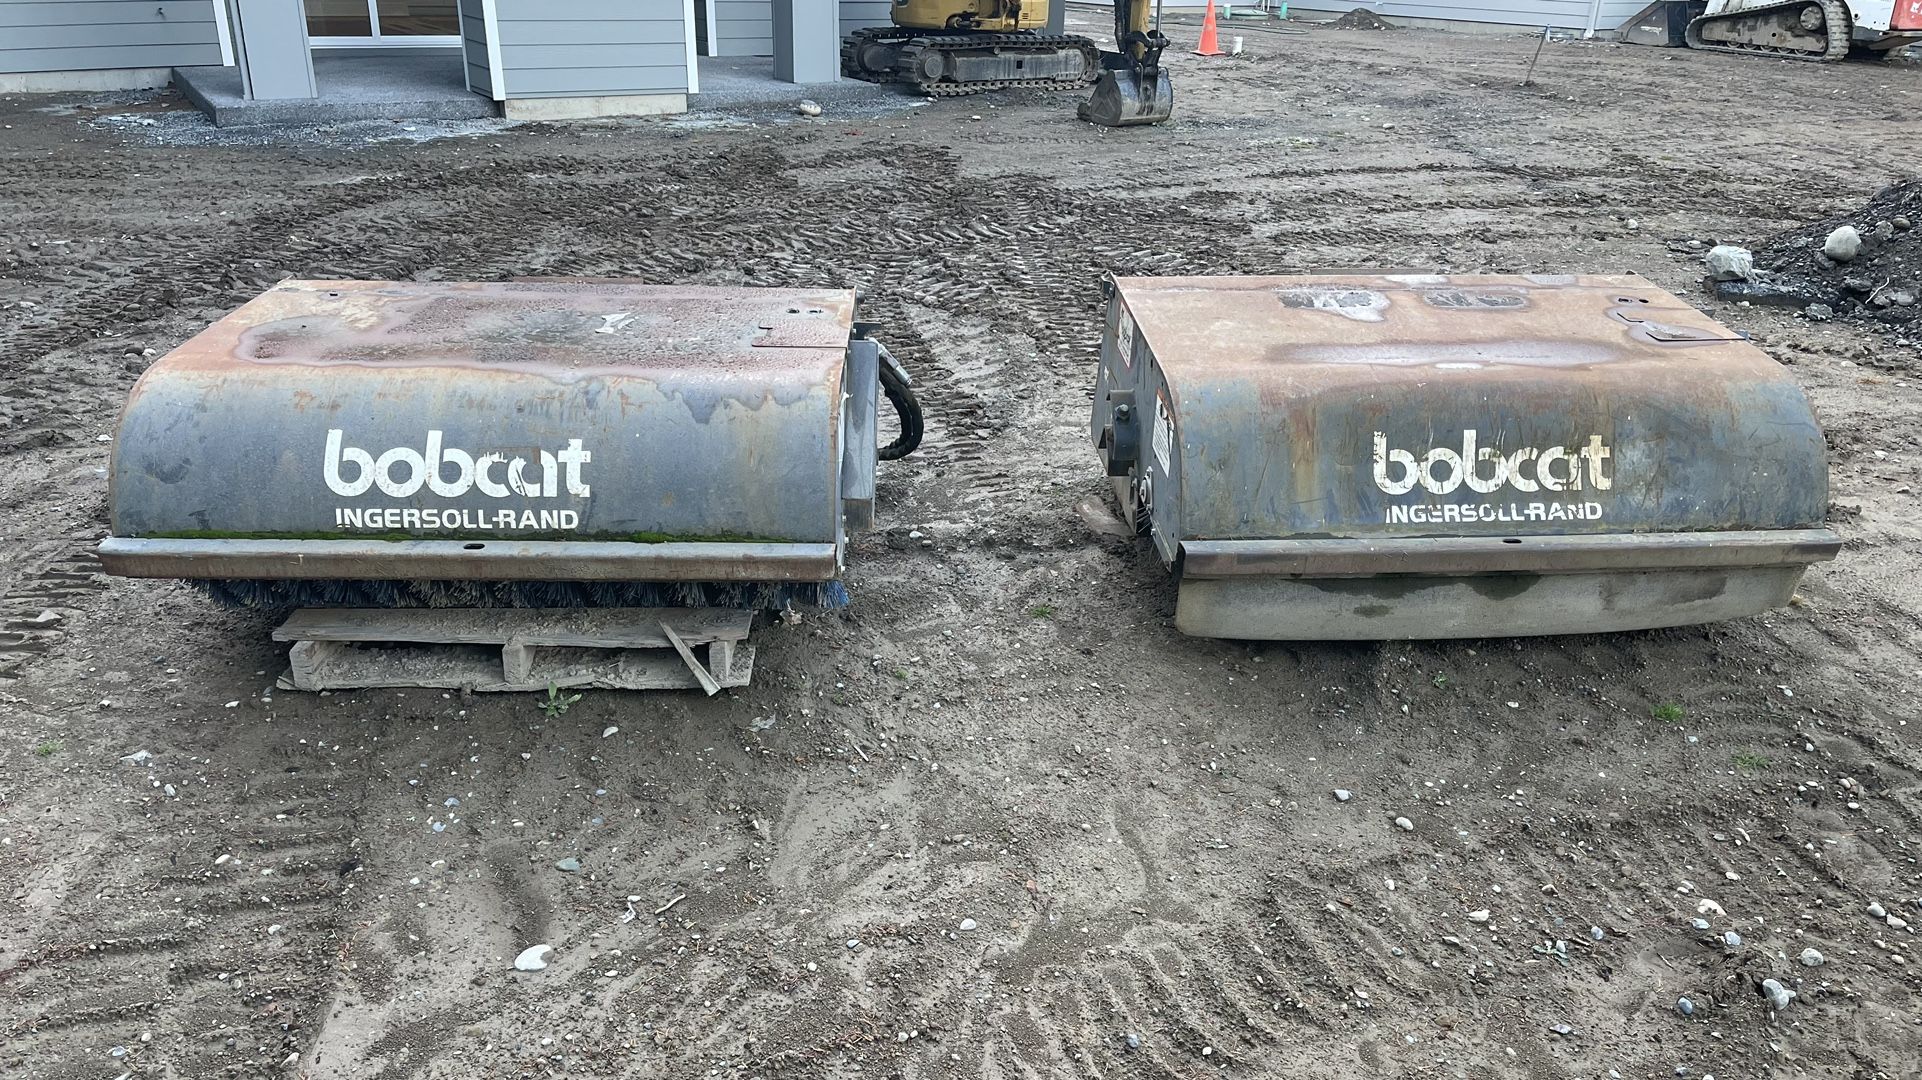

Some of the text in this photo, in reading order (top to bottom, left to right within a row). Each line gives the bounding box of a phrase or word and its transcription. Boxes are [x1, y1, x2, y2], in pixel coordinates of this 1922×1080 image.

[324, 429, 591, 497] bobcat
[1373, 429, 1612, 495] bobcat
[335, 508, 579, 529] INGERSOLL-RAND
[1386, 502, 1602, 523] INGERSOLL-RAND
